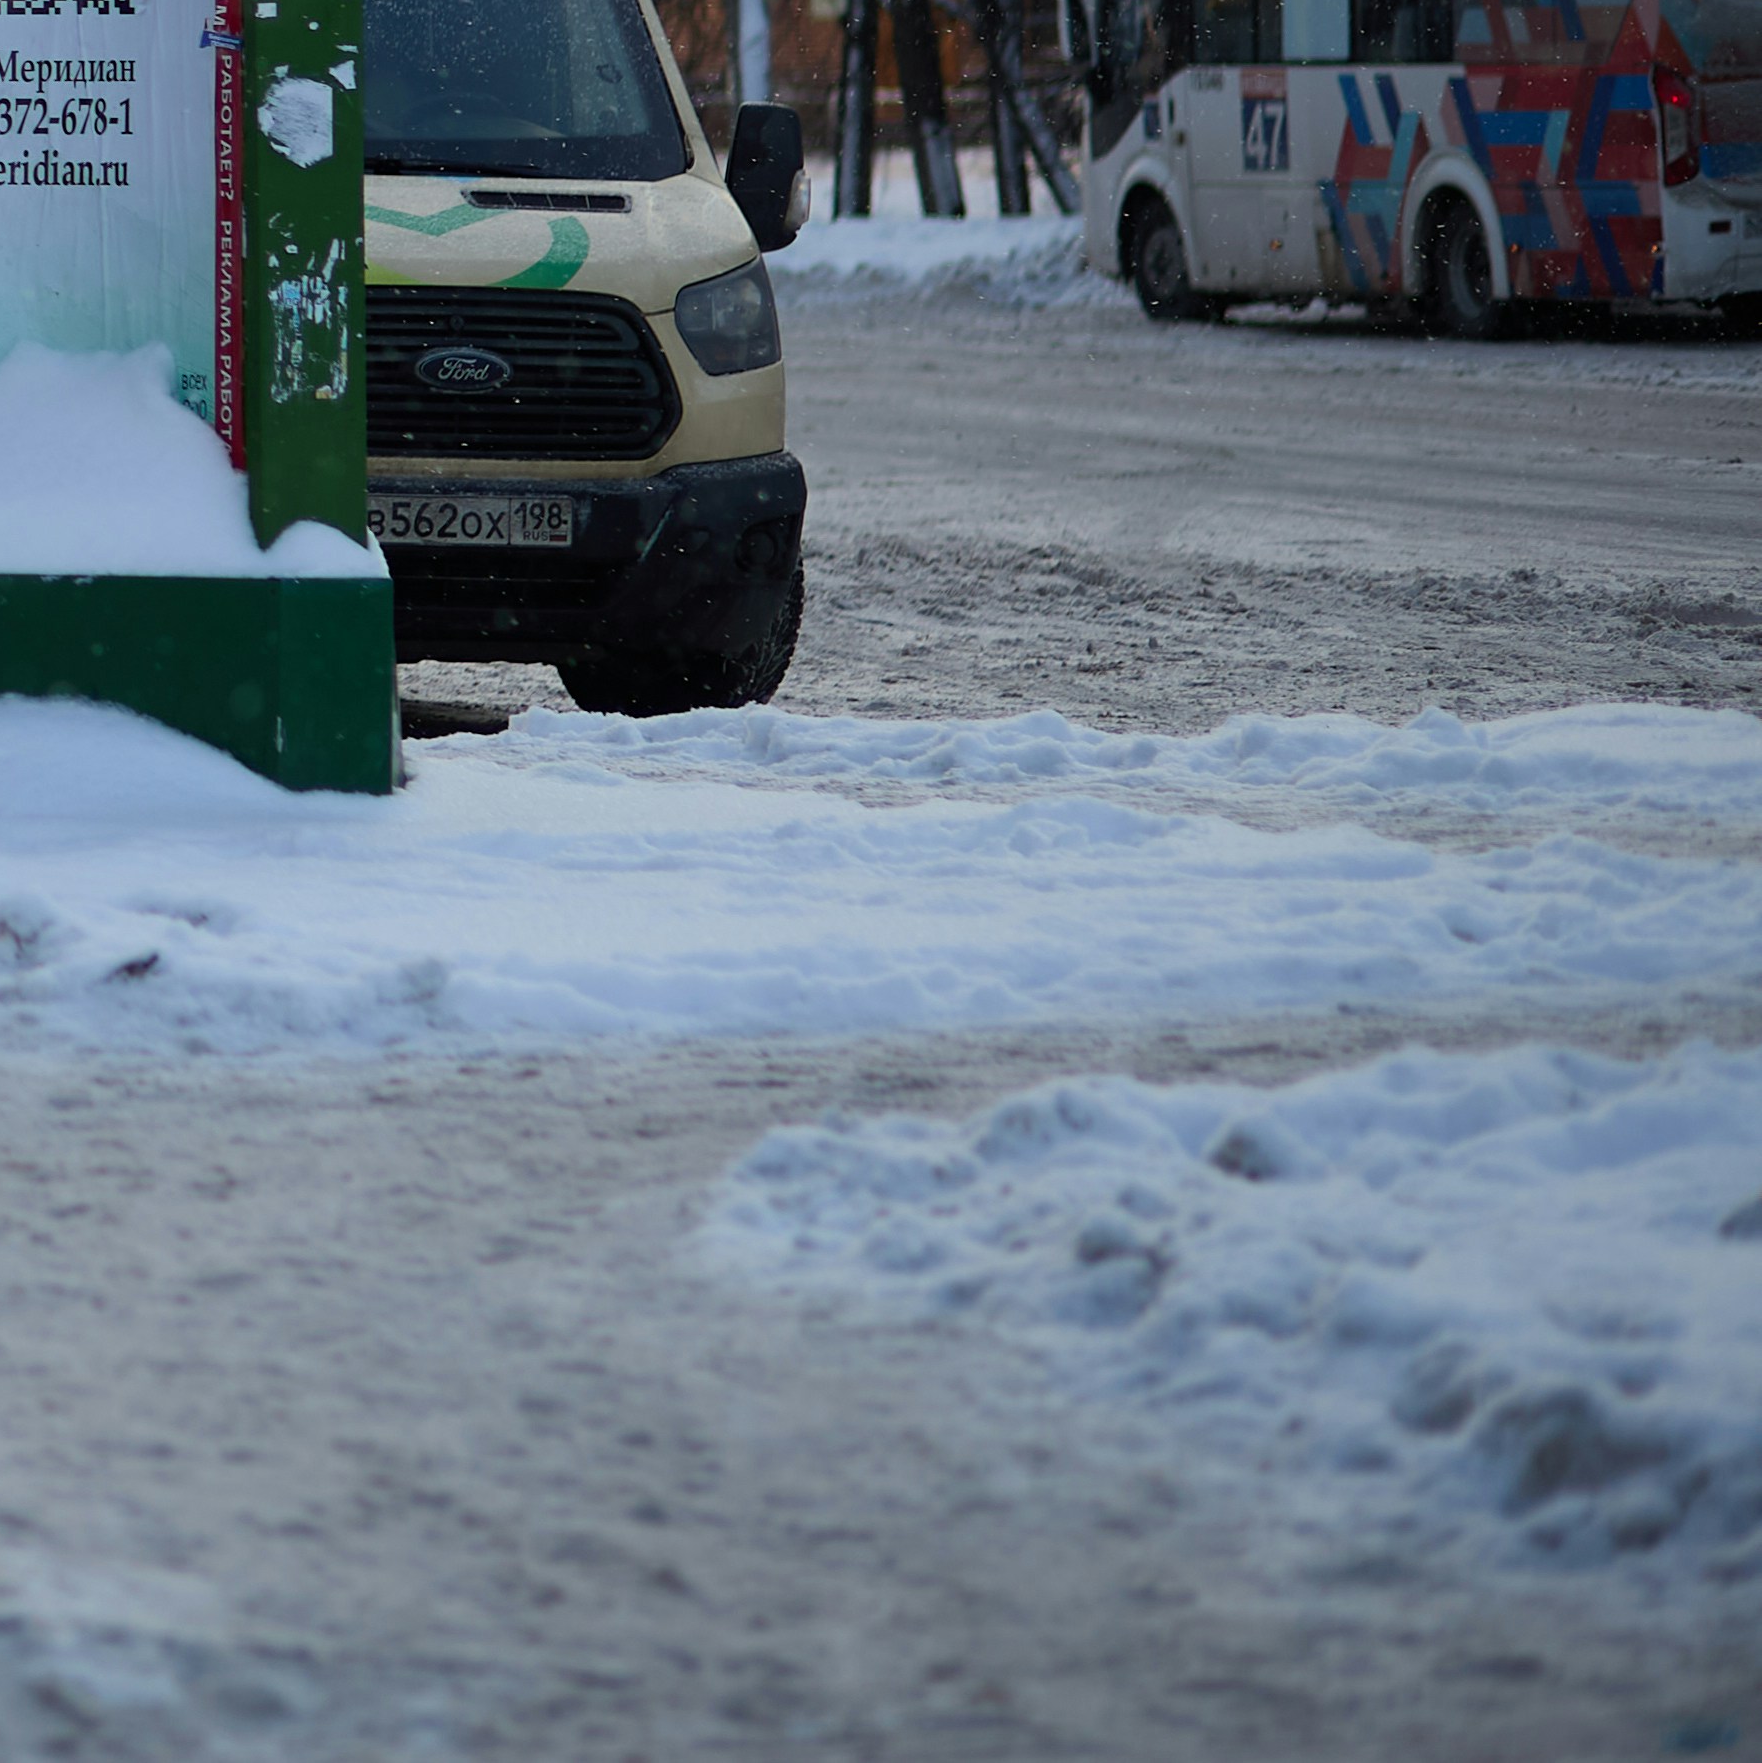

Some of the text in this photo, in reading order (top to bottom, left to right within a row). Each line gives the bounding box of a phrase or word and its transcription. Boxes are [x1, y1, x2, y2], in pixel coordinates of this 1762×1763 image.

[219, 54, 235, 202] РАБОТАЕТ?
[1246, 102, 1285, 168] 47
[220, 220, 233, 348] РЕКЛАМА
[181, 373, 208, 391] всех
[438, 356, 490, 381] Ford
[513, 501, 564, 530] 198
[524, 531, 550, 542] RUS
